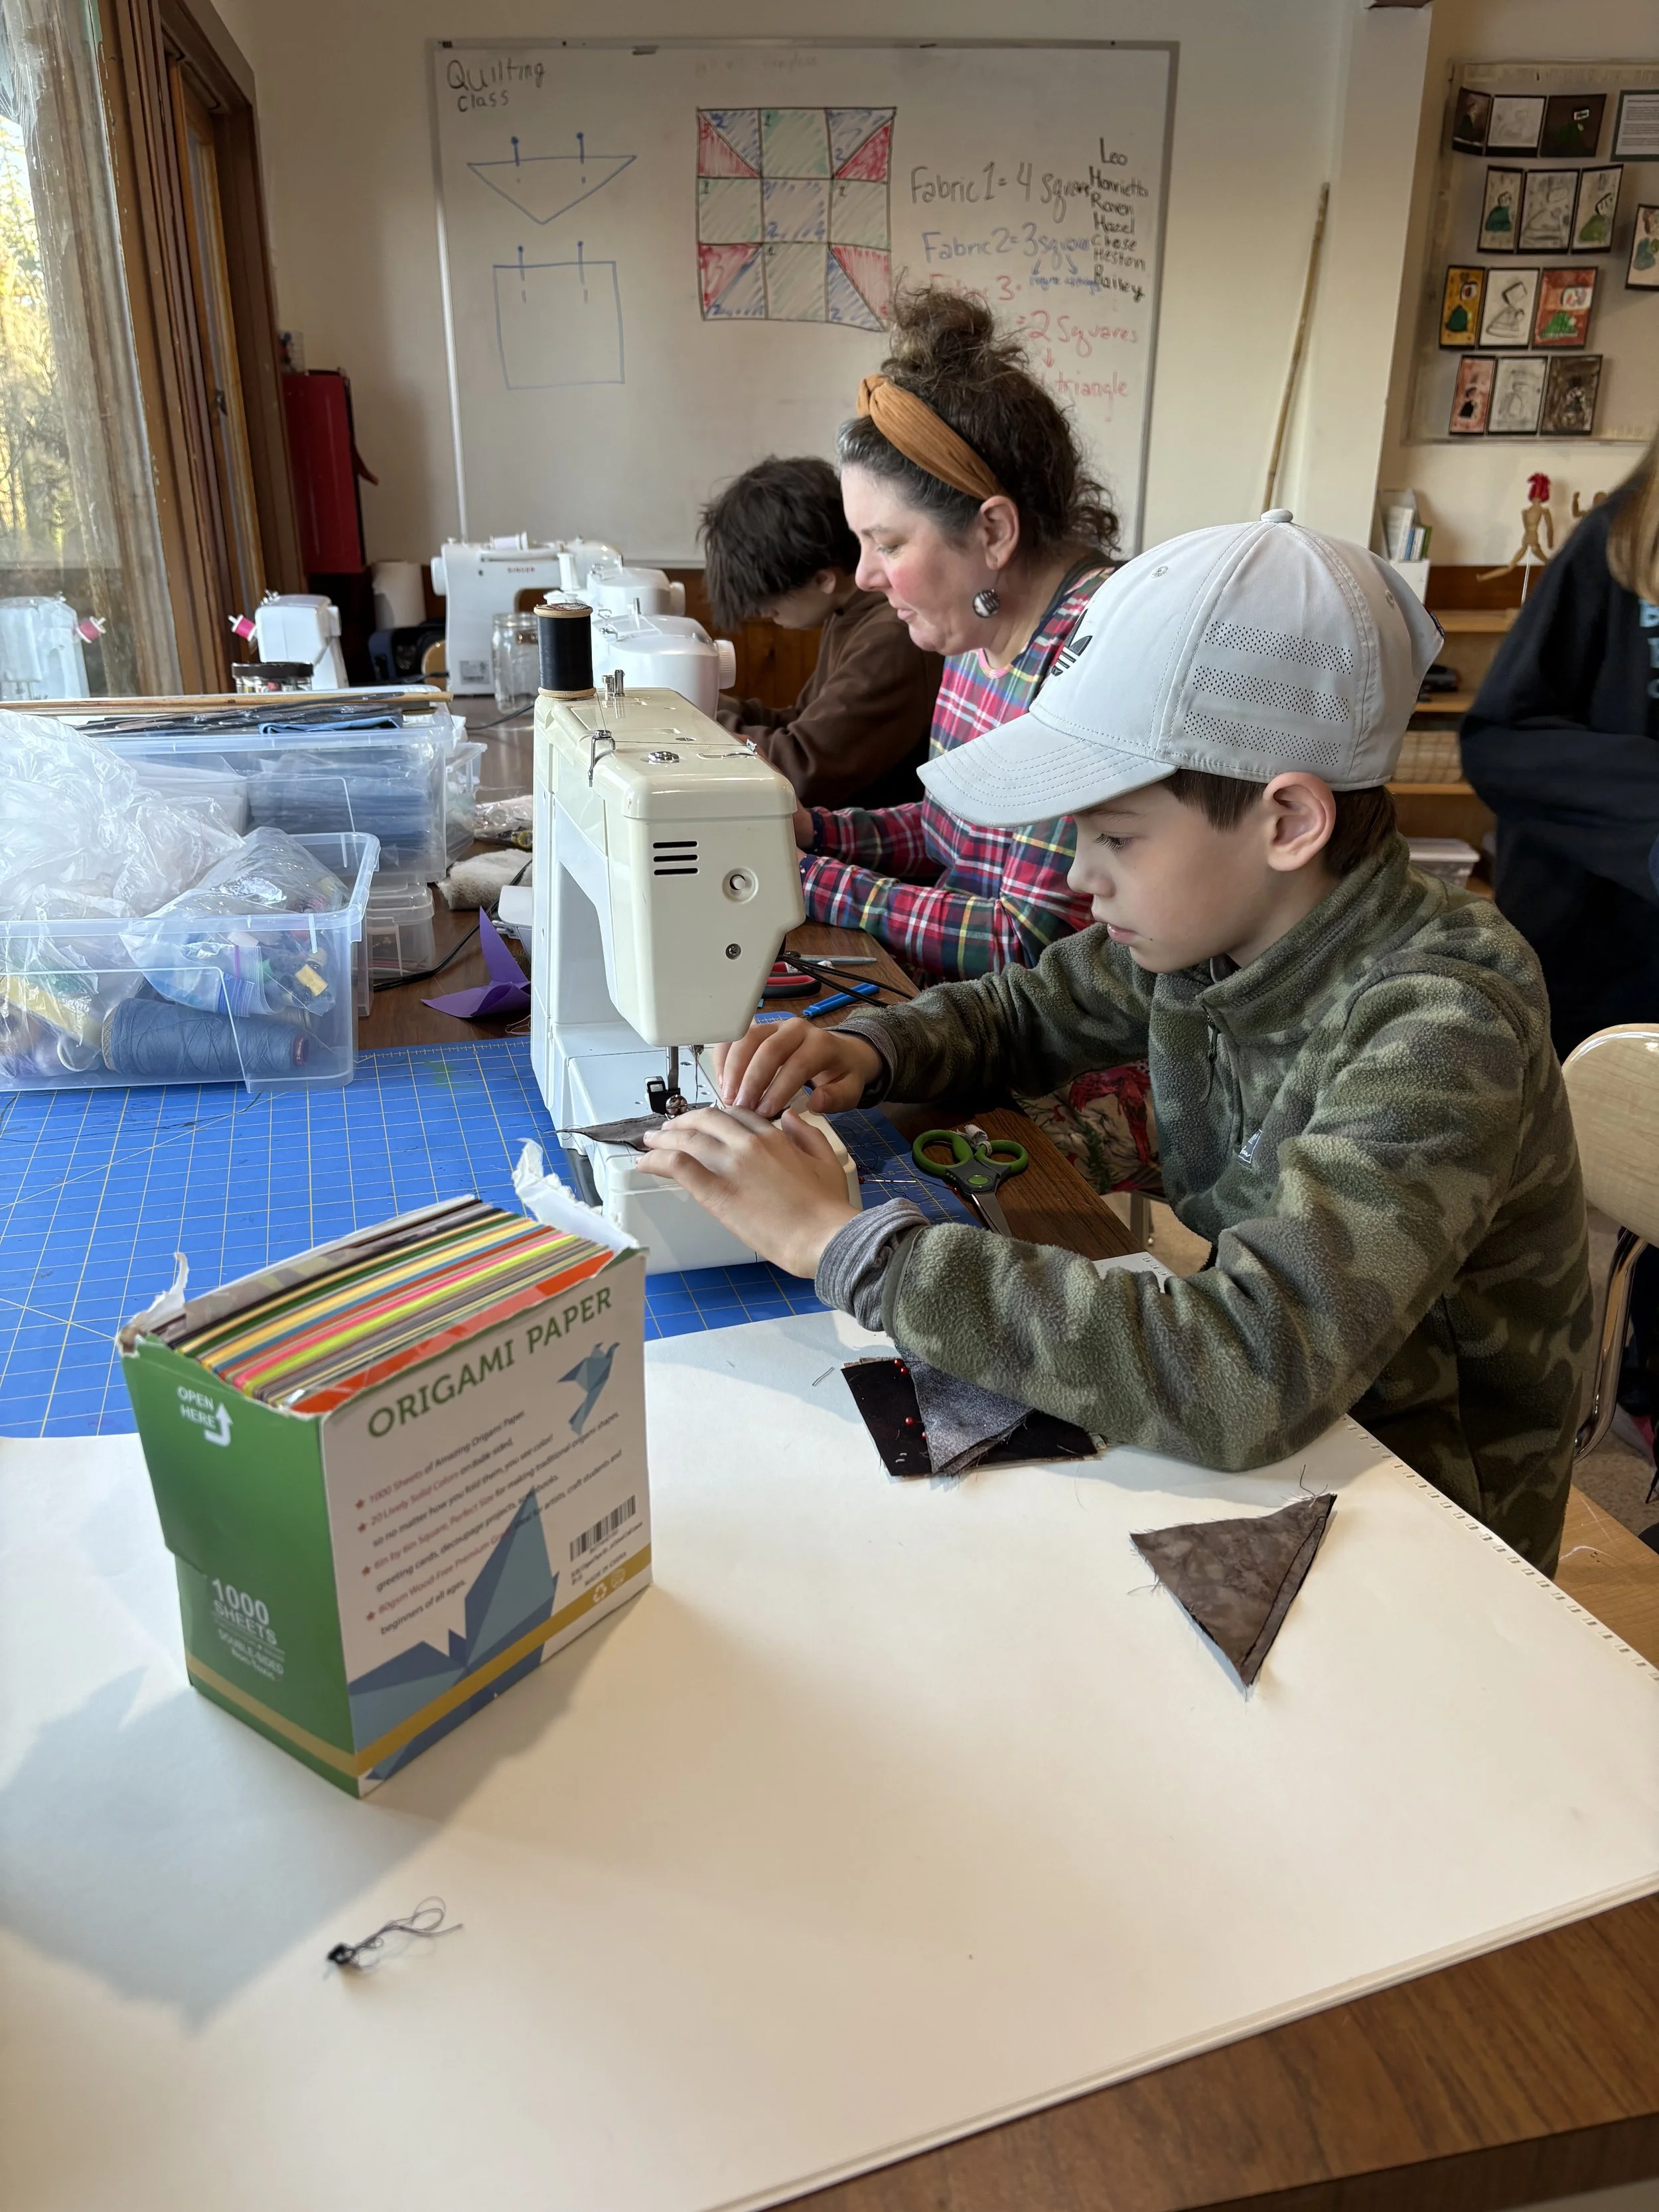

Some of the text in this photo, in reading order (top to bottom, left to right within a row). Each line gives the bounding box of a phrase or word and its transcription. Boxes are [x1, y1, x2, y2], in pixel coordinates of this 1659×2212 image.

[447, 57, 545, 92] Quilting
[1100, 137, 1128, 165] Leo
[911, 166, 979, 204] Fabric
[368, 1286, 613, 1438] ORIGAMI PAPER
[177, 1386, 214, 1411] OPEN
[180, 1404, 216, 1430] HERE
[212, 1578, 269, 1627] 1000
[214, 1599, 277, 1645] SHEETS
